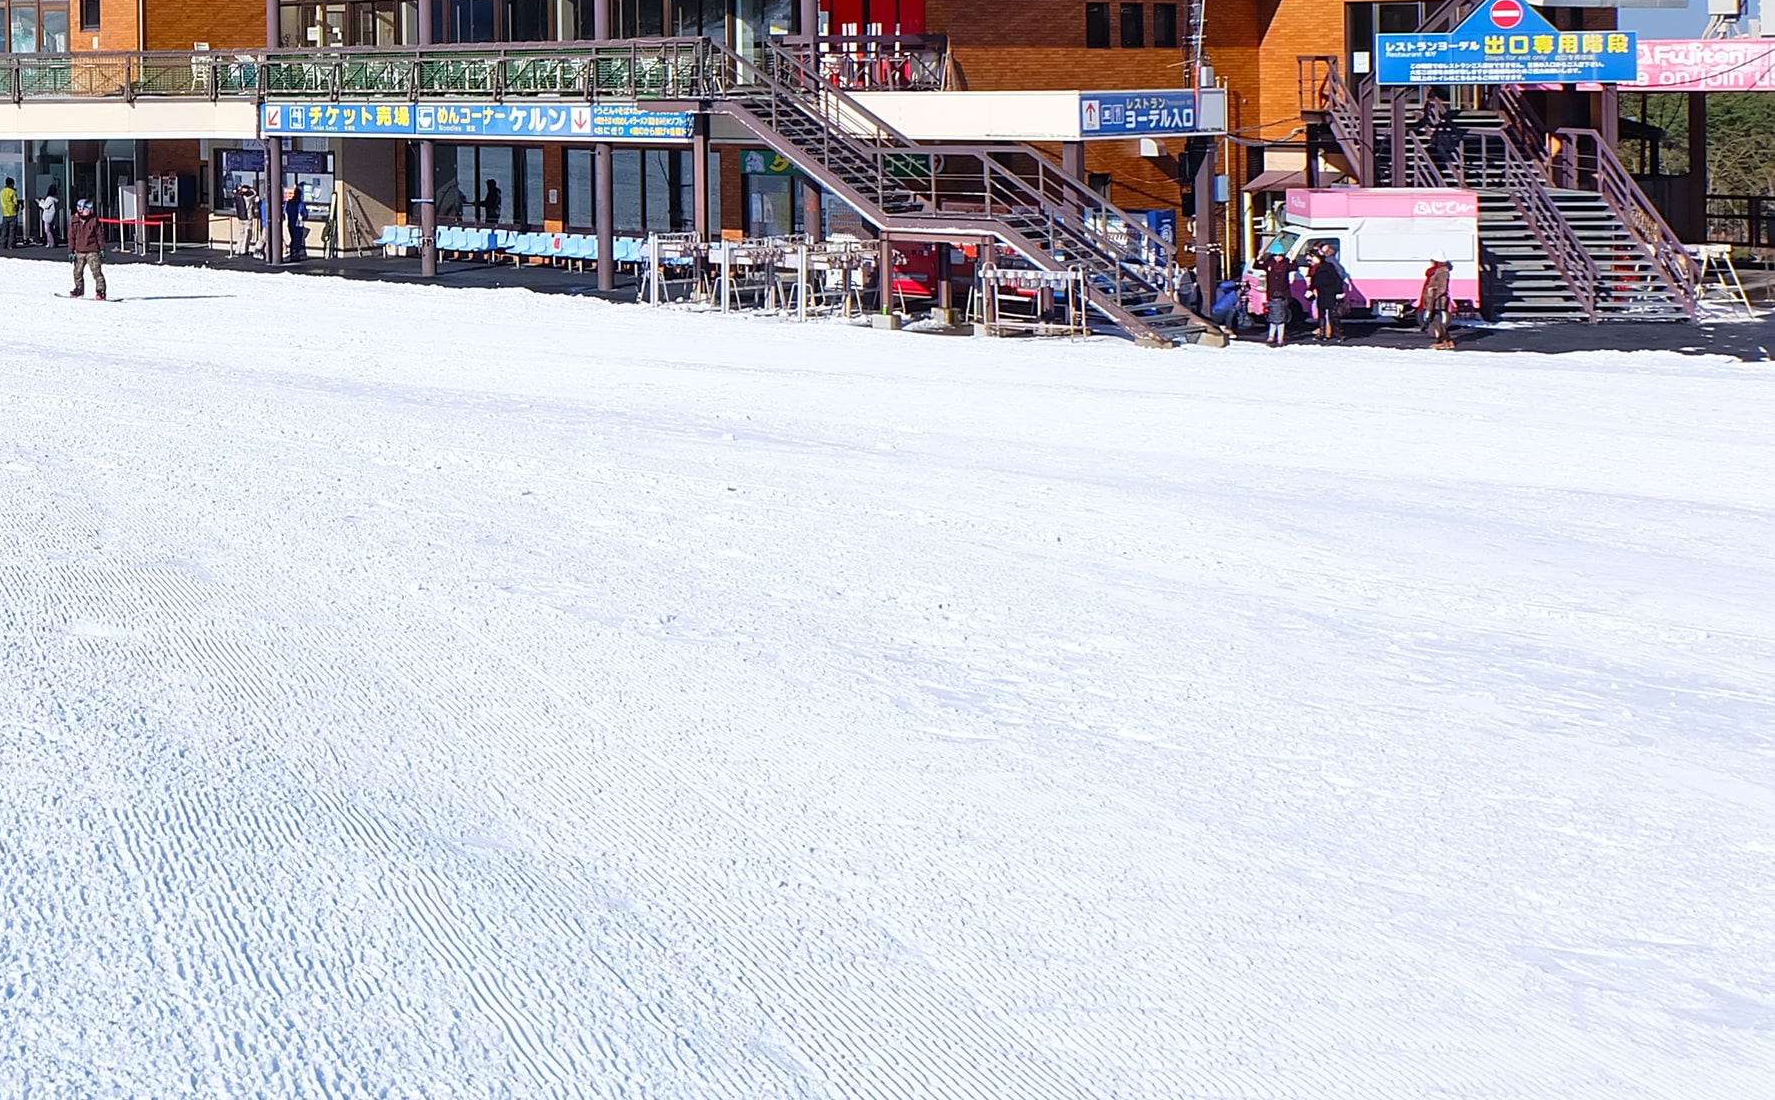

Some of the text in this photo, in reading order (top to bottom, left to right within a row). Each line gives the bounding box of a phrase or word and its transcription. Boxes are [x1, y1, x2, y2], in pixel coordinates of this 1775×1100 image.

[1484, 34, 1630, 55] 出口専用階段
[1654, 43, 1744, 67] Fujiten
[1533, 54, 1548, 62] only
[1659, 71, 1691, 86] on
[1699, 65, 1746, 88] join
[1126, 97, 1166, 109] レストラン
[308, 105, 410, 127] チケット売場
[437, 106, 567, 132] めんコーナー ケルン
[1413, 200, 1476, 215] ふじてん
